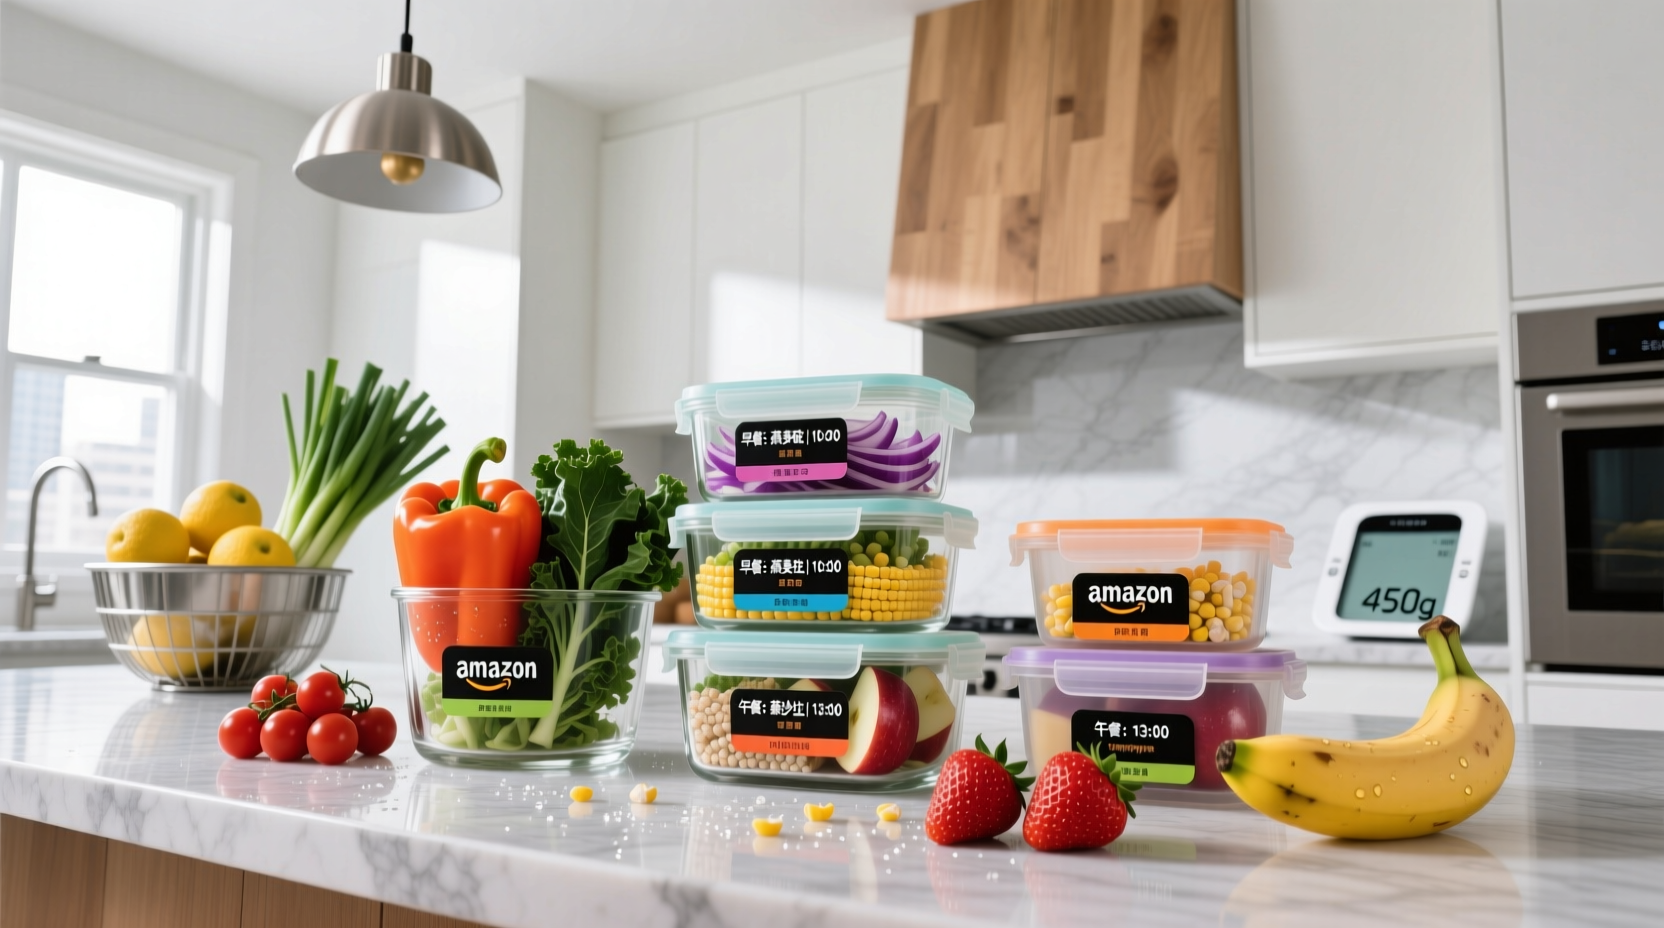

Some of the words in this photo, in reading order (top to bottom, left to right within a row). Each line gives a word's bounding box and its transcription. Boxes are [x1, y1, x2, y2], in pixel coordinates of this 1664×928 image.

[1088, 585, 1173, 604] amazon
[1362, 587, 1436, 621] 450g
[456, 660, 537, 679] amazon
[812, 702, 843, 717] 13:00
[1132, 723, 1170, 739] 13:00
